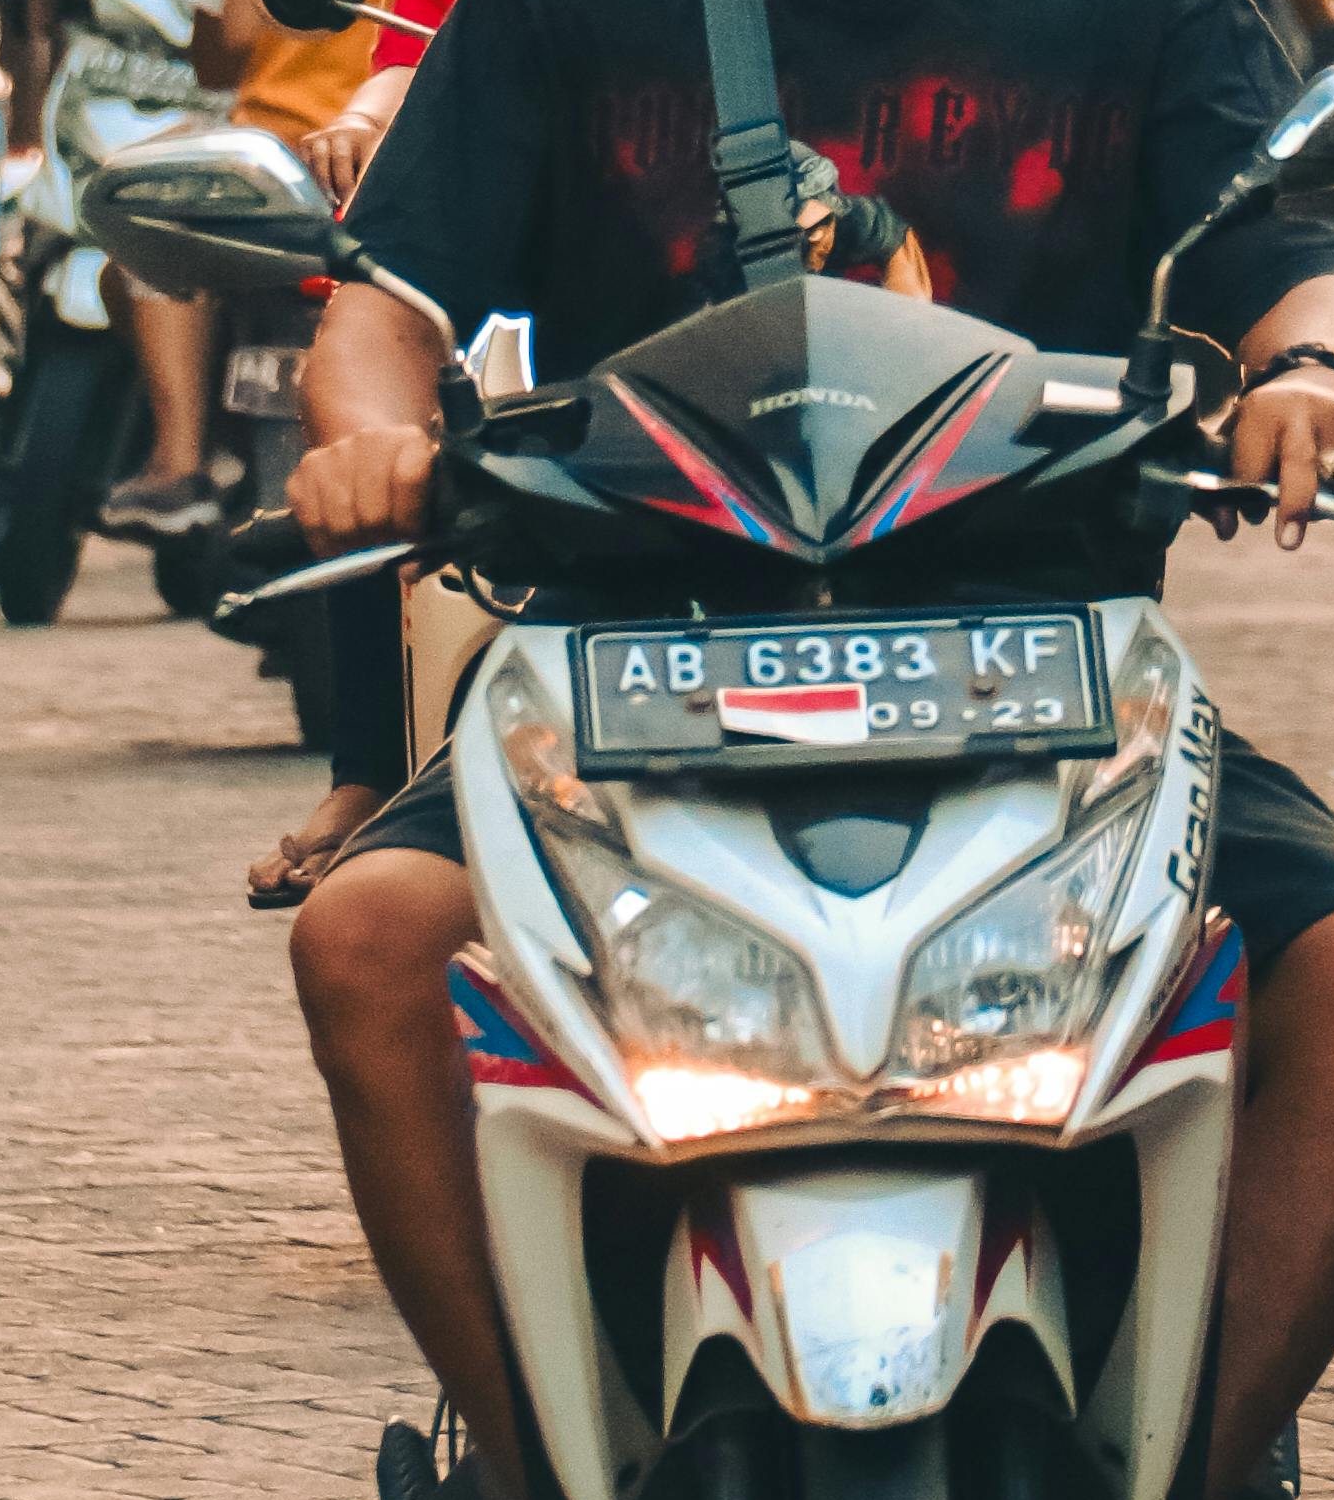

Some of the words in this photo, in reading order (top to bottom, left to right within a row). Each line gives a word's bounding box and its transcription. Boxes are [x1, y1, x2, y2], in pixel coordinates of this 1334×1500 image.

[748, 387, 877, 418] HONDA
[619, 643, 705, 693] AB
[747, 635, 937, 686] 6383
[970, 628, 1060, 678] KF
